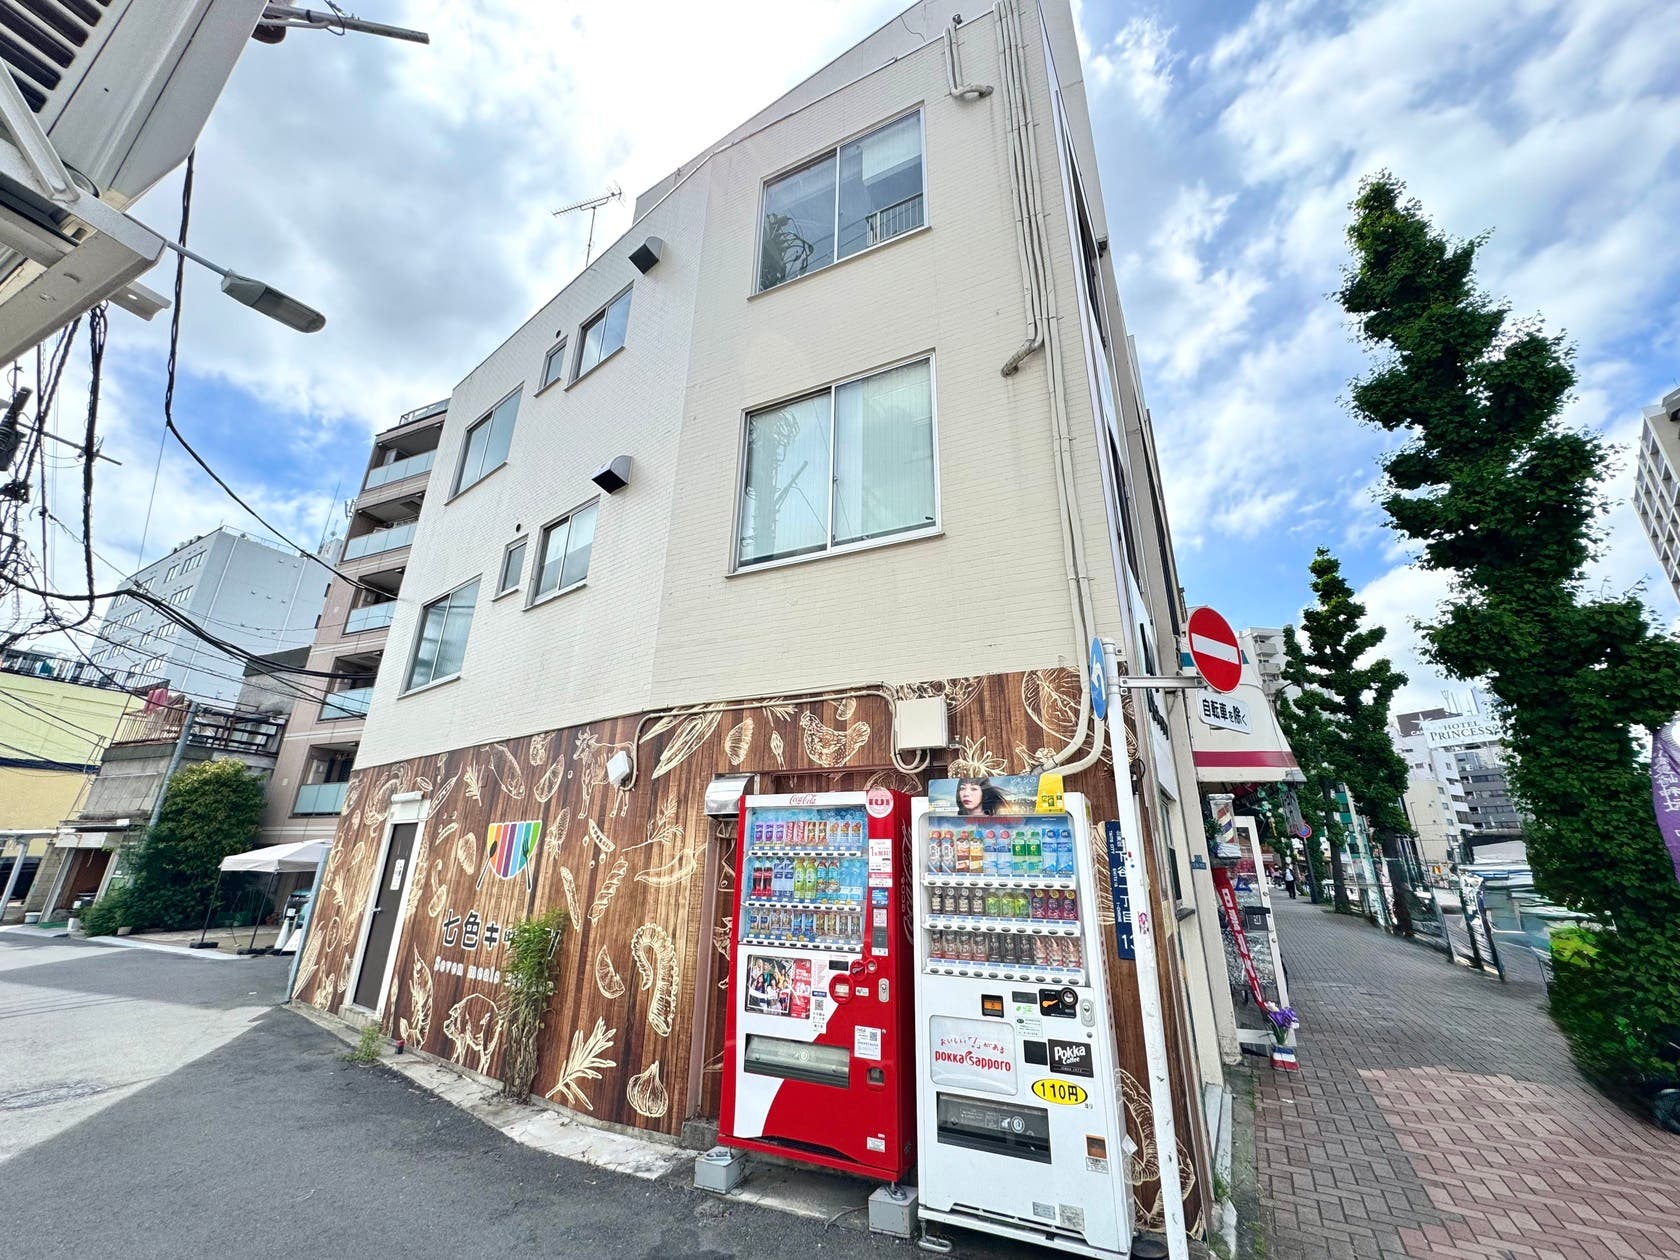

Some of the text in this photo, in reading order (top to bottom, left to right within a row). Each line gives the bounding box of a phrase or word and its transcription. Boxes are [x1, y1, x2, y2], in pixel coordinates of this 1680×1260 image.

[1202, 697, 1248, 726] 自転車を除く
[1430, 725, 1493, 741] PRINCESS
[1443, 720, 1480, 731] HOTEL
[433, 955, 464, 976] Seven
[467, 965, 501, 984] meals
[1054, 1045, 1086, 1062] Pokka
[1062, 1056, 1080, 1065] Coffee
[1040, 1083, 1078, 1102] 110円
